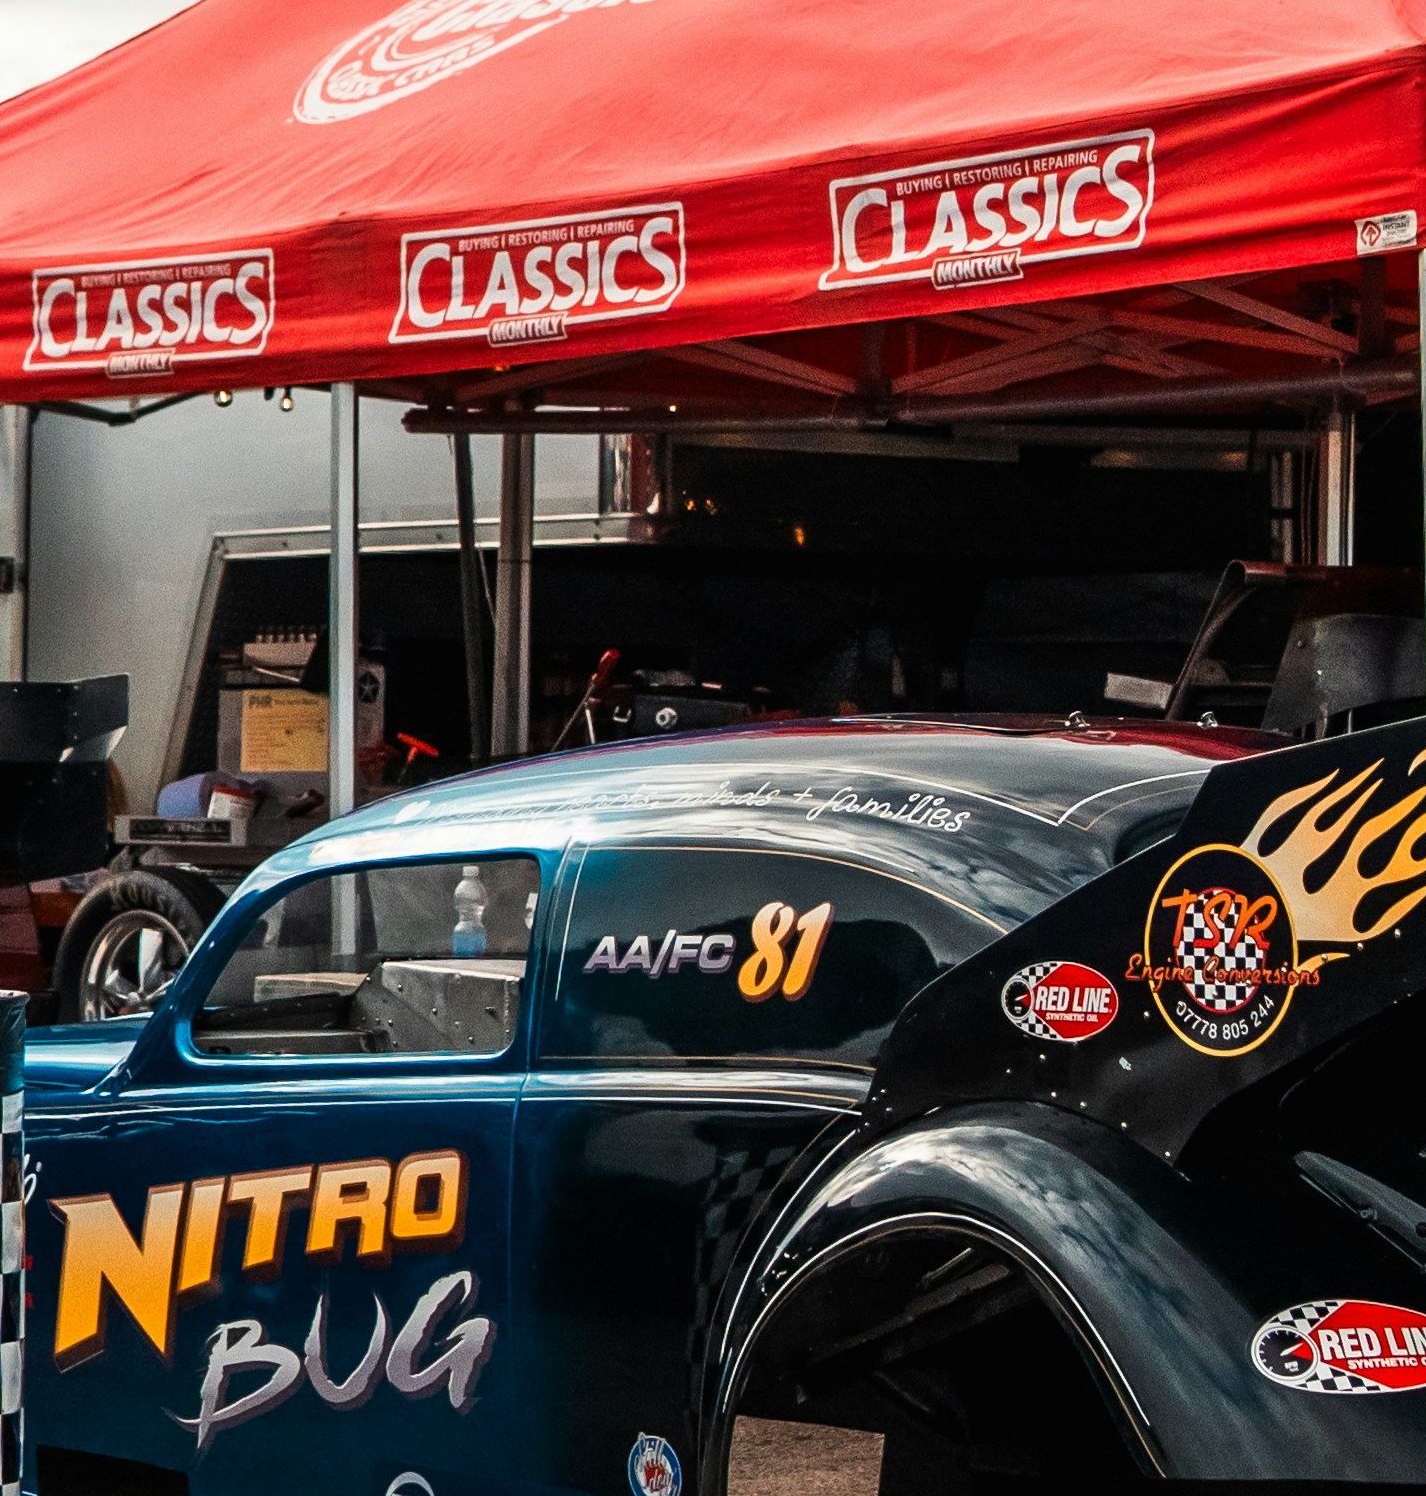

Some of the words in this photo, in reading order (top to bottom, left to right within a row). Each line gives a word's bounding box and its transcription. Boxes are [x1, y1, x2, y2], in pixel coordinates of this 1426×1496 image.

[896, 176, 942, 196] BUYING
[954, 163, 1021, 185] RESTORING
[1033, 150, 1098, 172] REPAIRING
[842, 145, 1143, 273] CLASSICS
[459, 236, 500, 252] BUYING
[508, 228, 568, 247] RESTORING
[577, 220, 634, 238] REPAIRING
[408, 217, 676, 327] CLASSICS
[936, 253, 1015, 282] MONTHLY
[40, 262, 266, 357] CLASSICS
[492, 315, 562, 342] MONTHLY
[806, 785, 971, 832] families
[1162, 889, 1277, 950] TSR
[583, 930, 736, 979] AA/FC
[738, 902, 833, 1003] 81
[1126, 953, 1194, 993] Engine
[1202, 956, 1320, 986] Conversions
[1035, 986, 1070, 1012] RED
[1072, 987, 1111, 1013] LINE
[1176, 1000, 1218, 1040] 07778
[1223, 1019, 1249, 1040] 805
[1250, 994, 1275, 1029] 244
[48, 1148, 468, 1372] NITRO
[164, 1270, 497, 1449] BUG
[1318, 1327, 1381, 1360] RED
[1348, 1358, 1418, 1370] SYNTHETIC
